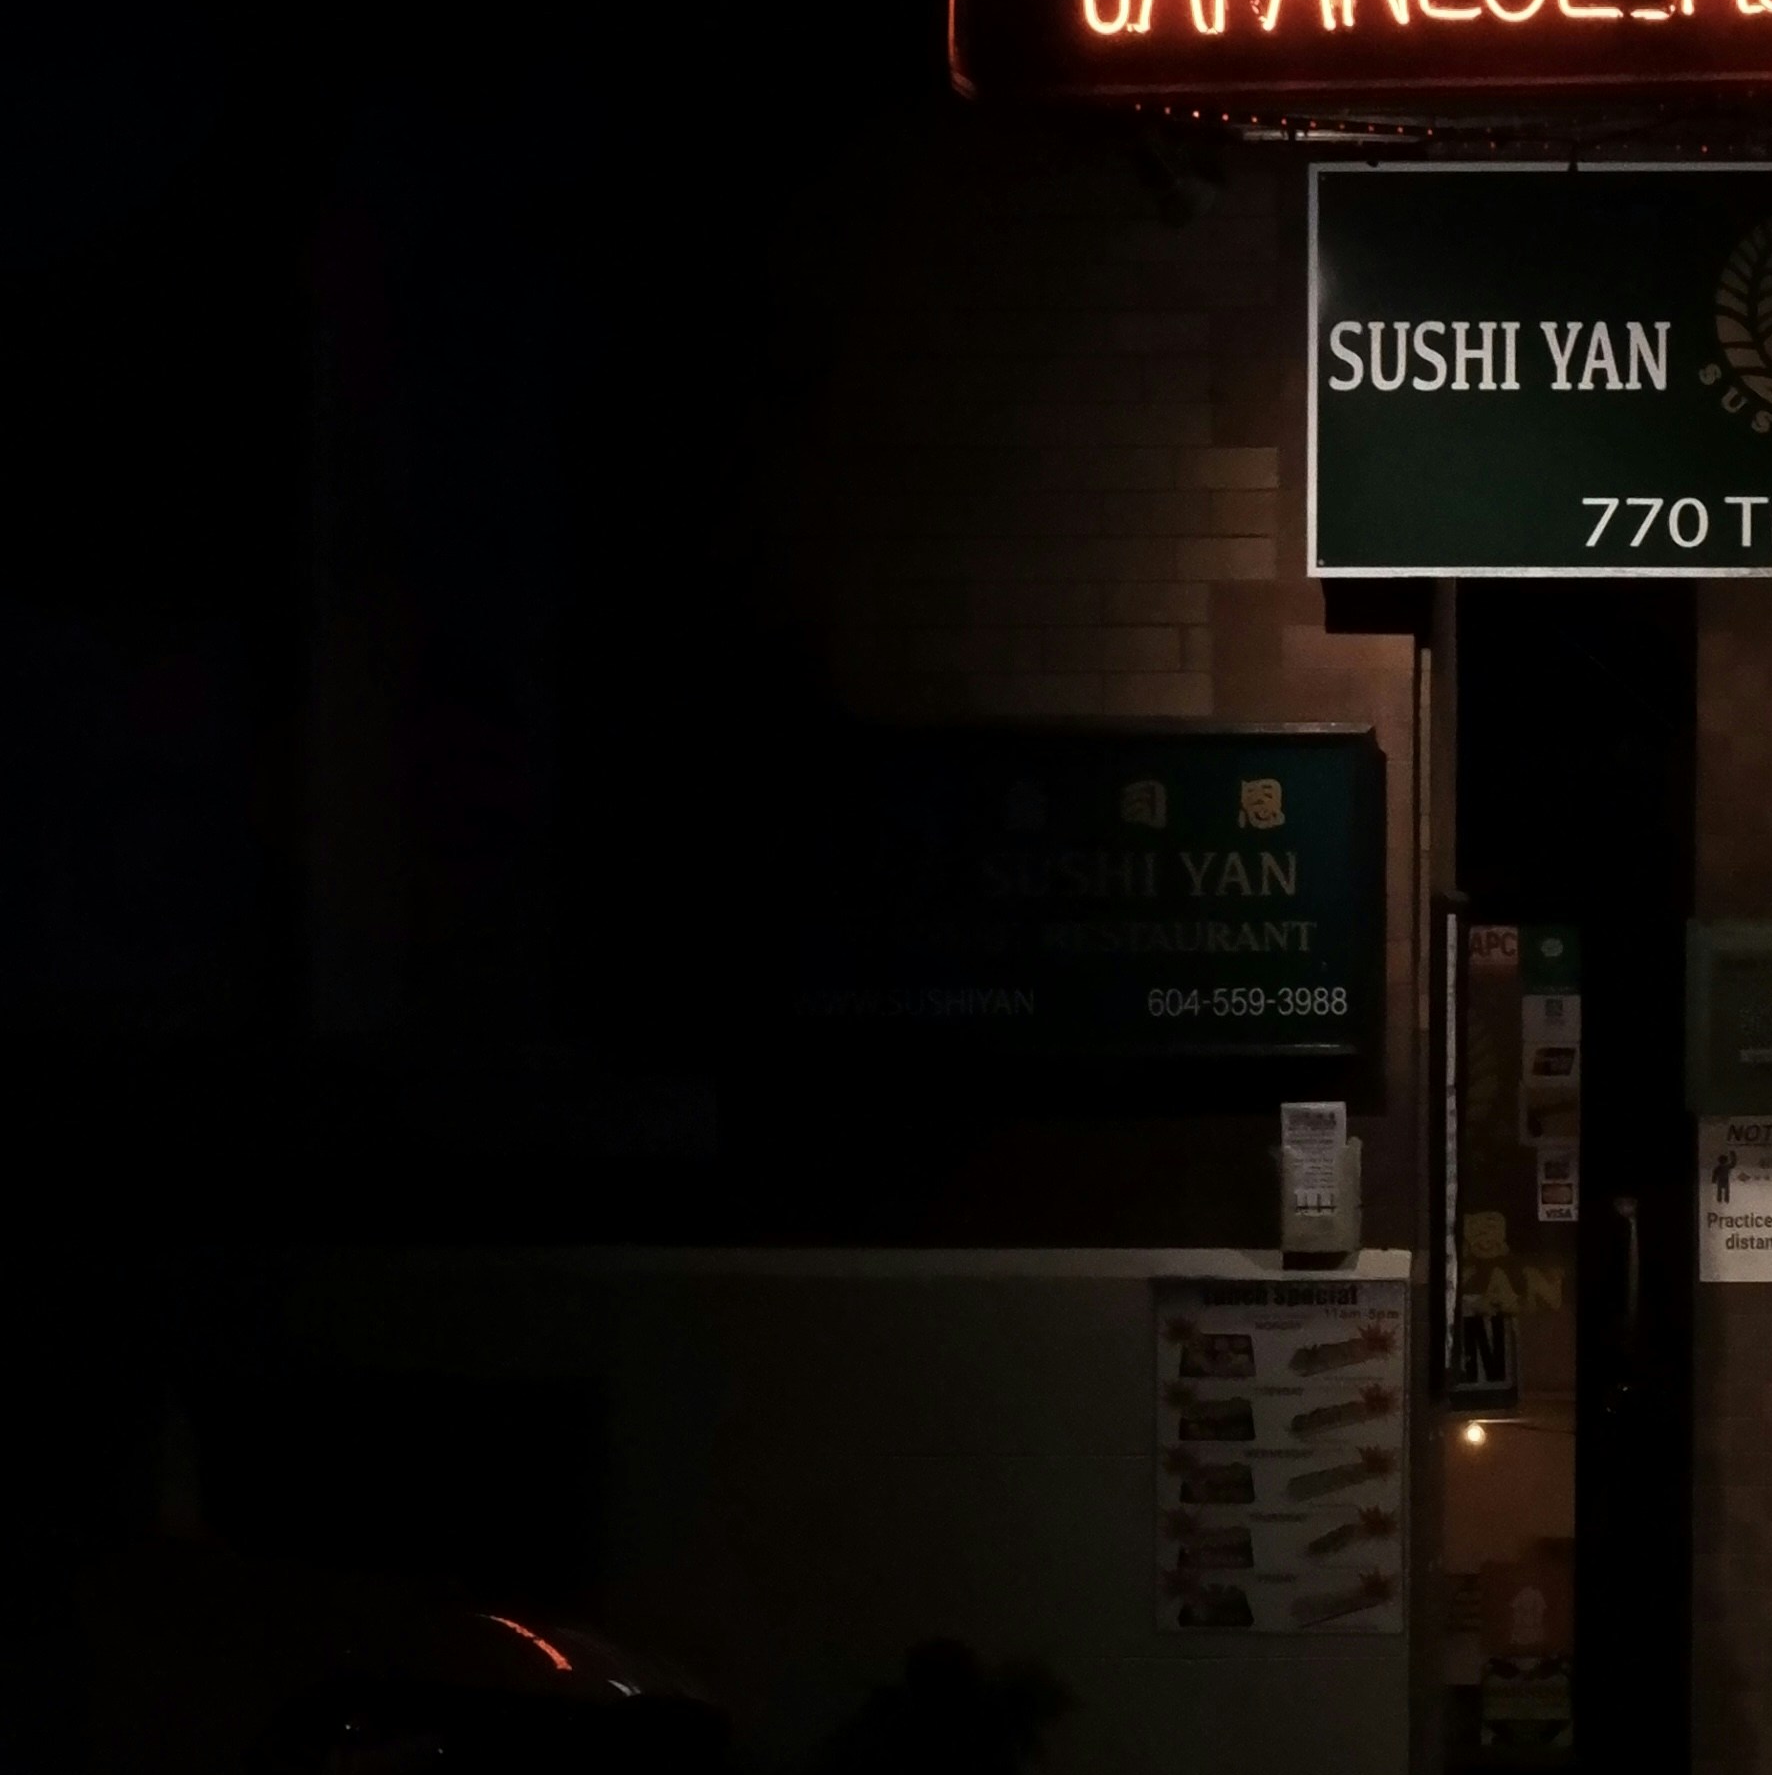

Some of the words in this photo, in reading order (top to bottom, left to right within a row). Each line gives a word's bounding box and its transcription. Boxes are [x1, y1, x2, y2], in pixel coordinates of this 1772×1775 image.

[1328, 320, 1521, 392] SUSHI
[1540, 320, 1672, 391] YAN
[1581, 497, 1710, 549] 770
[1177, 850, 1298, 898] YAN
[1147, 986, 1349, 1018] 604-559-3988
[1273, 1284, 1358, 1307] Special
